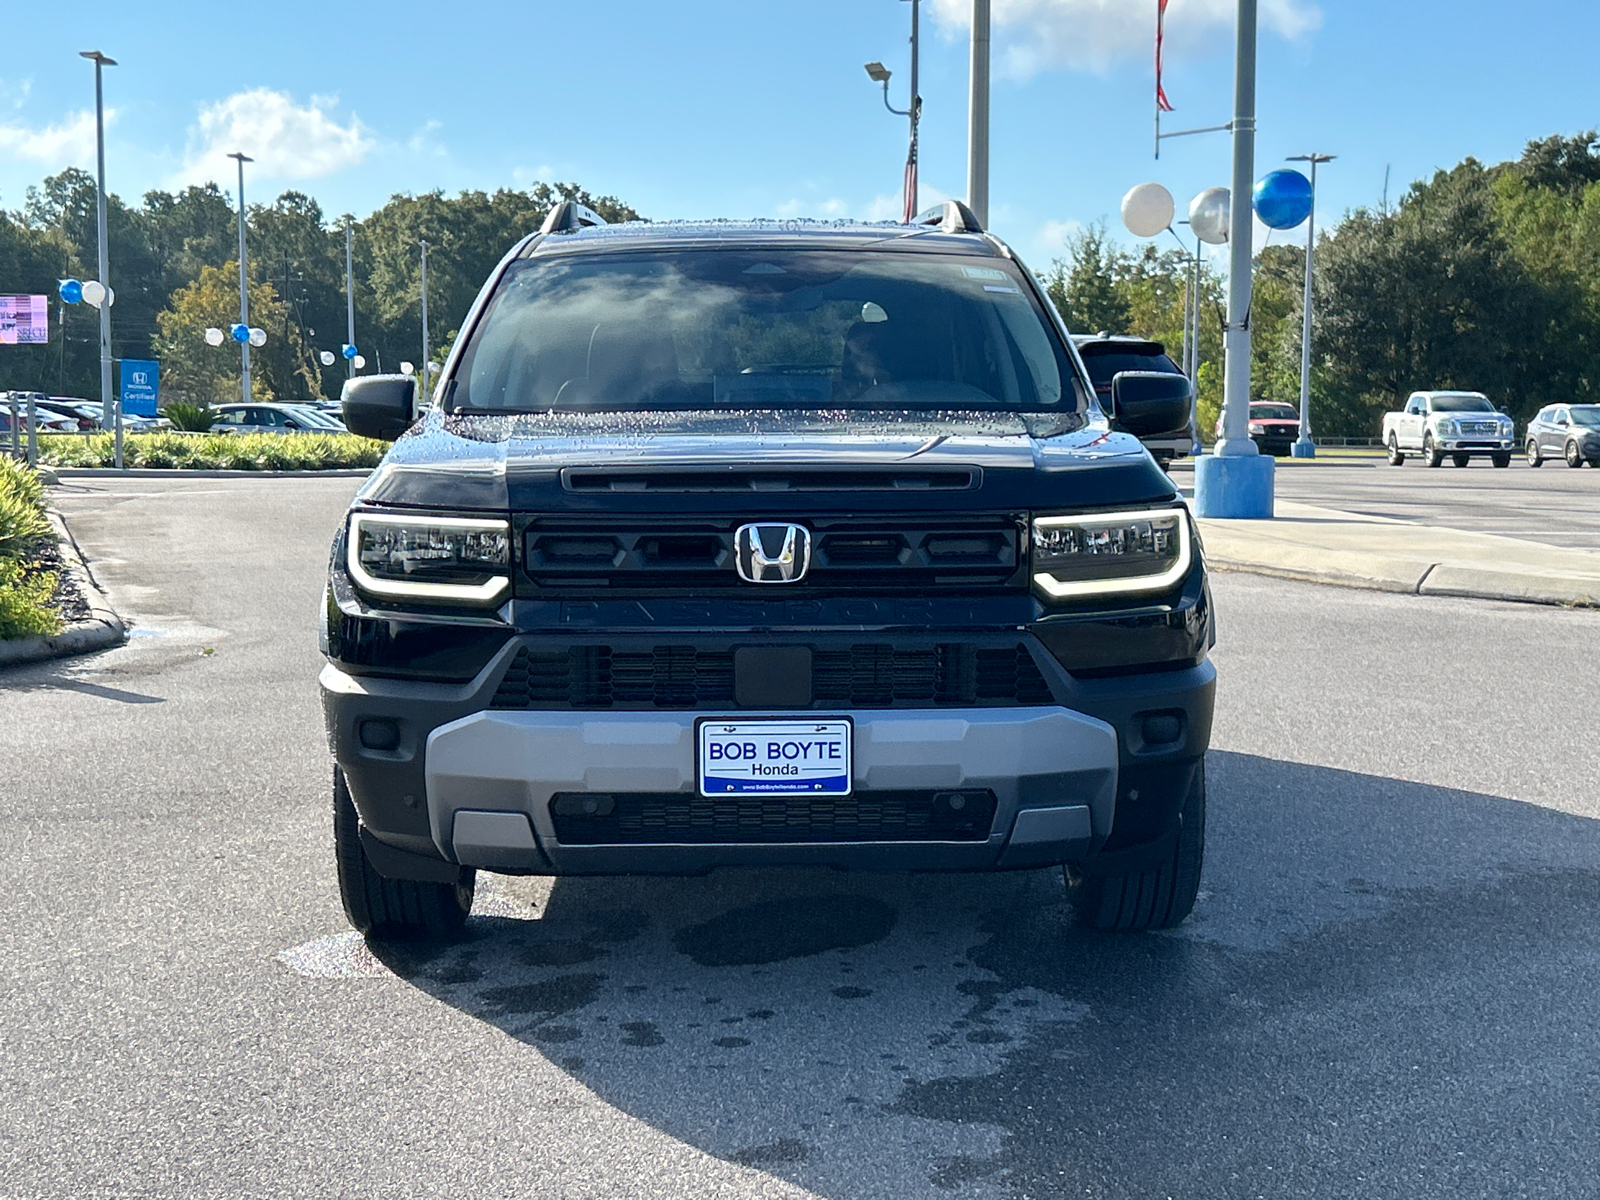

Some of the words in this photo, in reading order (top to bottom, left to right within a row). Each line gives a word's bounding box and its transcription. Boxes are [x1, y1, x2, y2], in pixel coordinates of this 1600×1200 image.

[124, 391, 155, 400] Certified
[559, 600, 986, 623] PASSPORT
[709, 742, 757, 760] BOB
[767, 741, 842, 760] BOYTE
[752, 763, 799, 776] Honda
